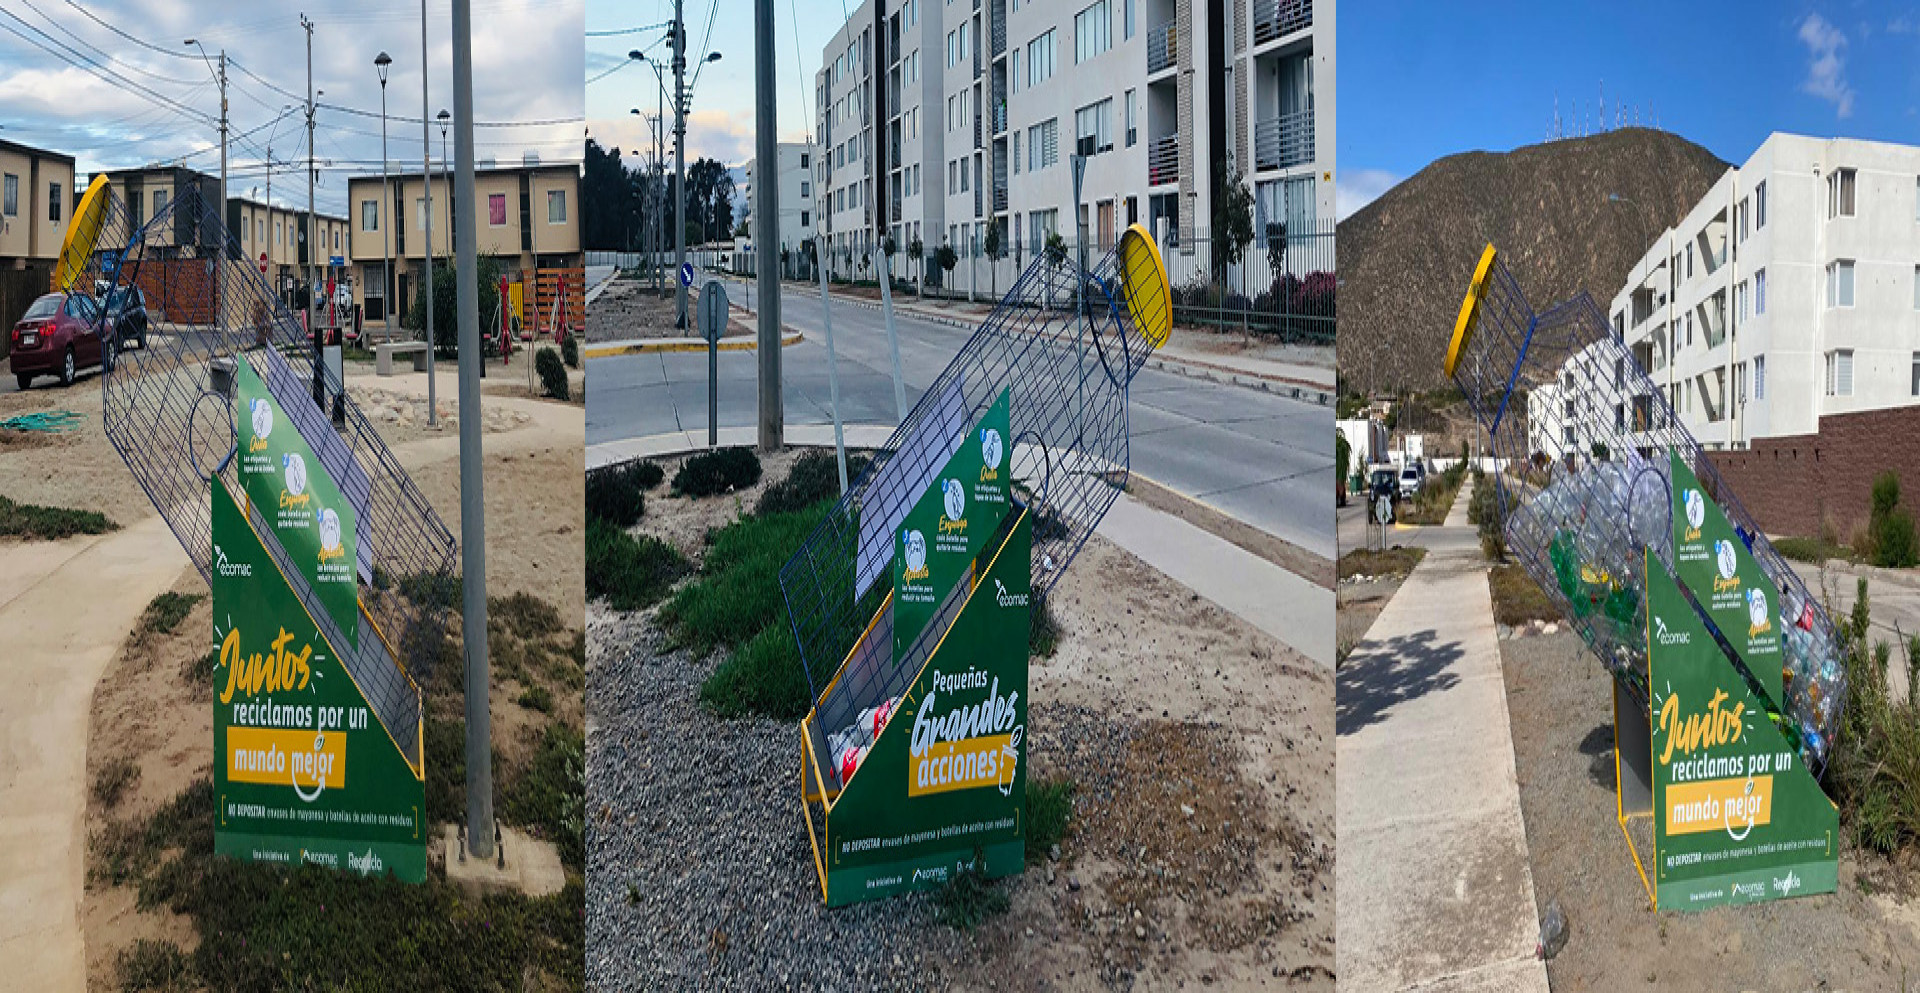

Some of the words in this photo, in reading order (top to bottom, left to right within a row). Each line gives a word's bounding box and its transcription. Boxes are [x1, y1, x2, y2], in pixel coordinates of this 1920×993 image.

[250, 434, 267, 452] Quita
[980, 464, 997, 482] Quita
[220, 563, 251, 577] ecomac
[903, 564, 929, 586] Aplasta
[999, 593, 1028, 607] ecomac
[1660, 632, 1690, 645] ecomac
[219, 625, 312, 705] Juntos
[933, 665, 988, 695] Pequeñas
[233, 697, 313, 728] reciclamos
[318, 705, 344, 734] por
[348, 706, 368, 730] un
[910, 675, 1019, 758] Grandes
[1659, 687, 1745, 765] Juntos
[234, 742, 285, 772] mundo
[291, 735, 335, 783] mejor
[917, 745, 997, 788] acciones
[1672, 752, 1744, 782] reciclamos
[1749, 752, 1771, 780] por
[1775, 751, 1792, 772] un
[228, 802, 236, 817] NO
[237, 803, 266, 819] DEPOSITAR
[266, 807, 288, 819] envases
[289, 806, 296, 819] de
[297, 809, 324, 822] mayonesa
[325, 812, 329, 824] y
[329, 809, 352, 823] botellas
[352, 810, 360, 822] de
[360, 811, 377, 825] aceite
[378, 813, 389, 825] con
[389, 812, 413, 827] residuos
[1673, 794, 1719, 824] mundo
[1724, 781, 1762, 822] mejor
[842, 841, 850, 853] NO
[851, 837, 880, 852] DEPOSITAR
[882, 836, 903, 848] envases
[903, 834, 910, 844] de
[911, 830, 936, 843] mayonesa
[936, 829, 941, 840] y
[941, 824, 961, 838] botellas
[961, 822, 968, 833] de
[968, 820, 984, 832] aceite
[984, 820, 994, 831] con
[994, 816, 1015, 828] residuos
[310, 852, 338, 866] ecomac
[1667, 855, 1674, 867] NO
[1675, 851, 1701, 866] DEPOSITAR
[1703, 851, 1722, 861] envases
[1723, 849, 1729, 859] de
[1730, 847, 1753, 858] mayonesa
[1753, 848, 1757, 856] y
[1757, 843, 1776, 854] botellas
[1777, 842, 1783, 850] de
[1783, 840, 1797, 850] aceite
[1798, 840, 1806, 849] con
[1806, 838, 1826, 847] residuos
[922, 866, 947, 880] ecomac
[1740, 882, 1765, 894] ecomac
